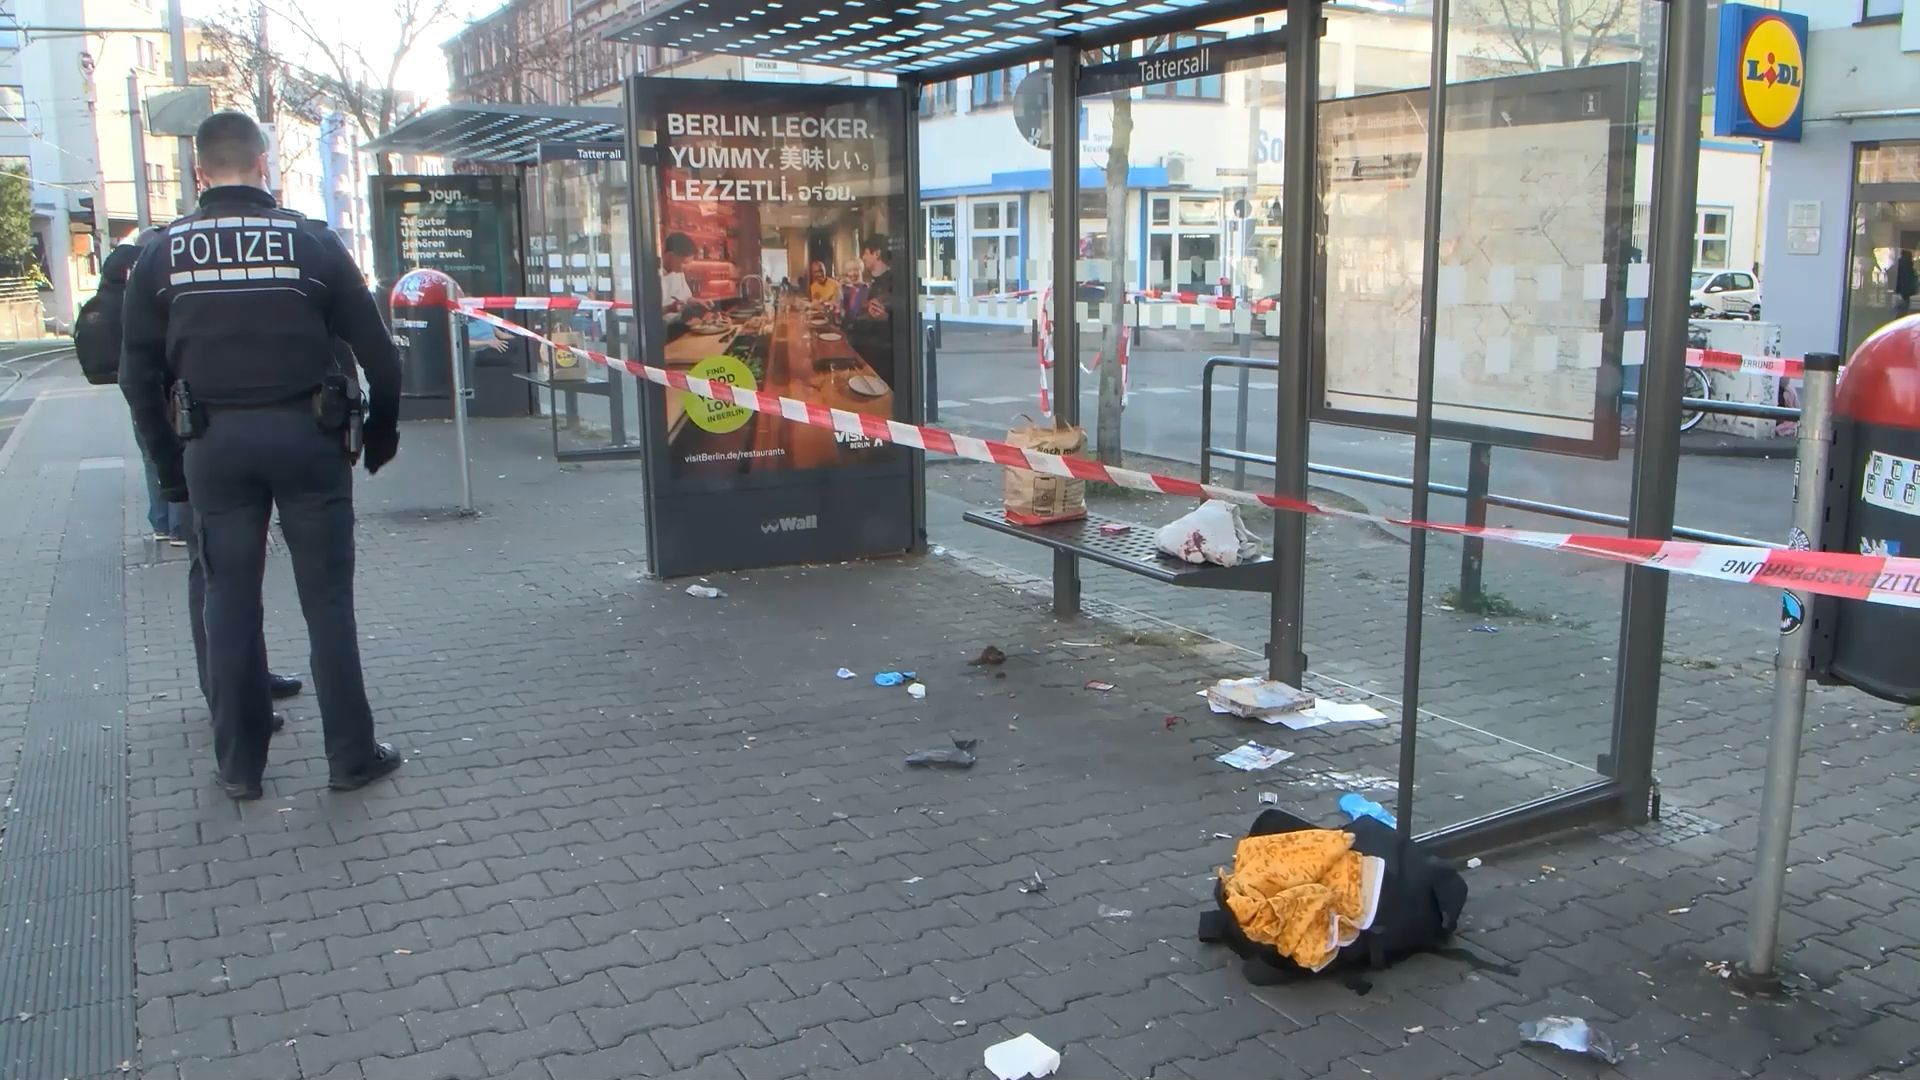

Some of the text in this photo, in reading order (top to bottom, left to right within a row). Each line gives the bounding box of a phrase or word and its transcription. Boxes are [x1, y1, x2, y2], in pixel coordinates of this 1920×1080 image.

[1139, 47, 1208, 82] Tattersall
[667, 113, 875, 139] BERLIN. LECKER.
[669, 145, 869, 171] YUMMY. 美味しい。
[401, 227, 473, 238] Unterhaltung
[417, 217, 447, 228] guter
[171, 231, 295, 267] POLIZEI
[684, 448, 785, 463] visitBerlin.de/restaurants
[779, 514, 818, 531] Wall
